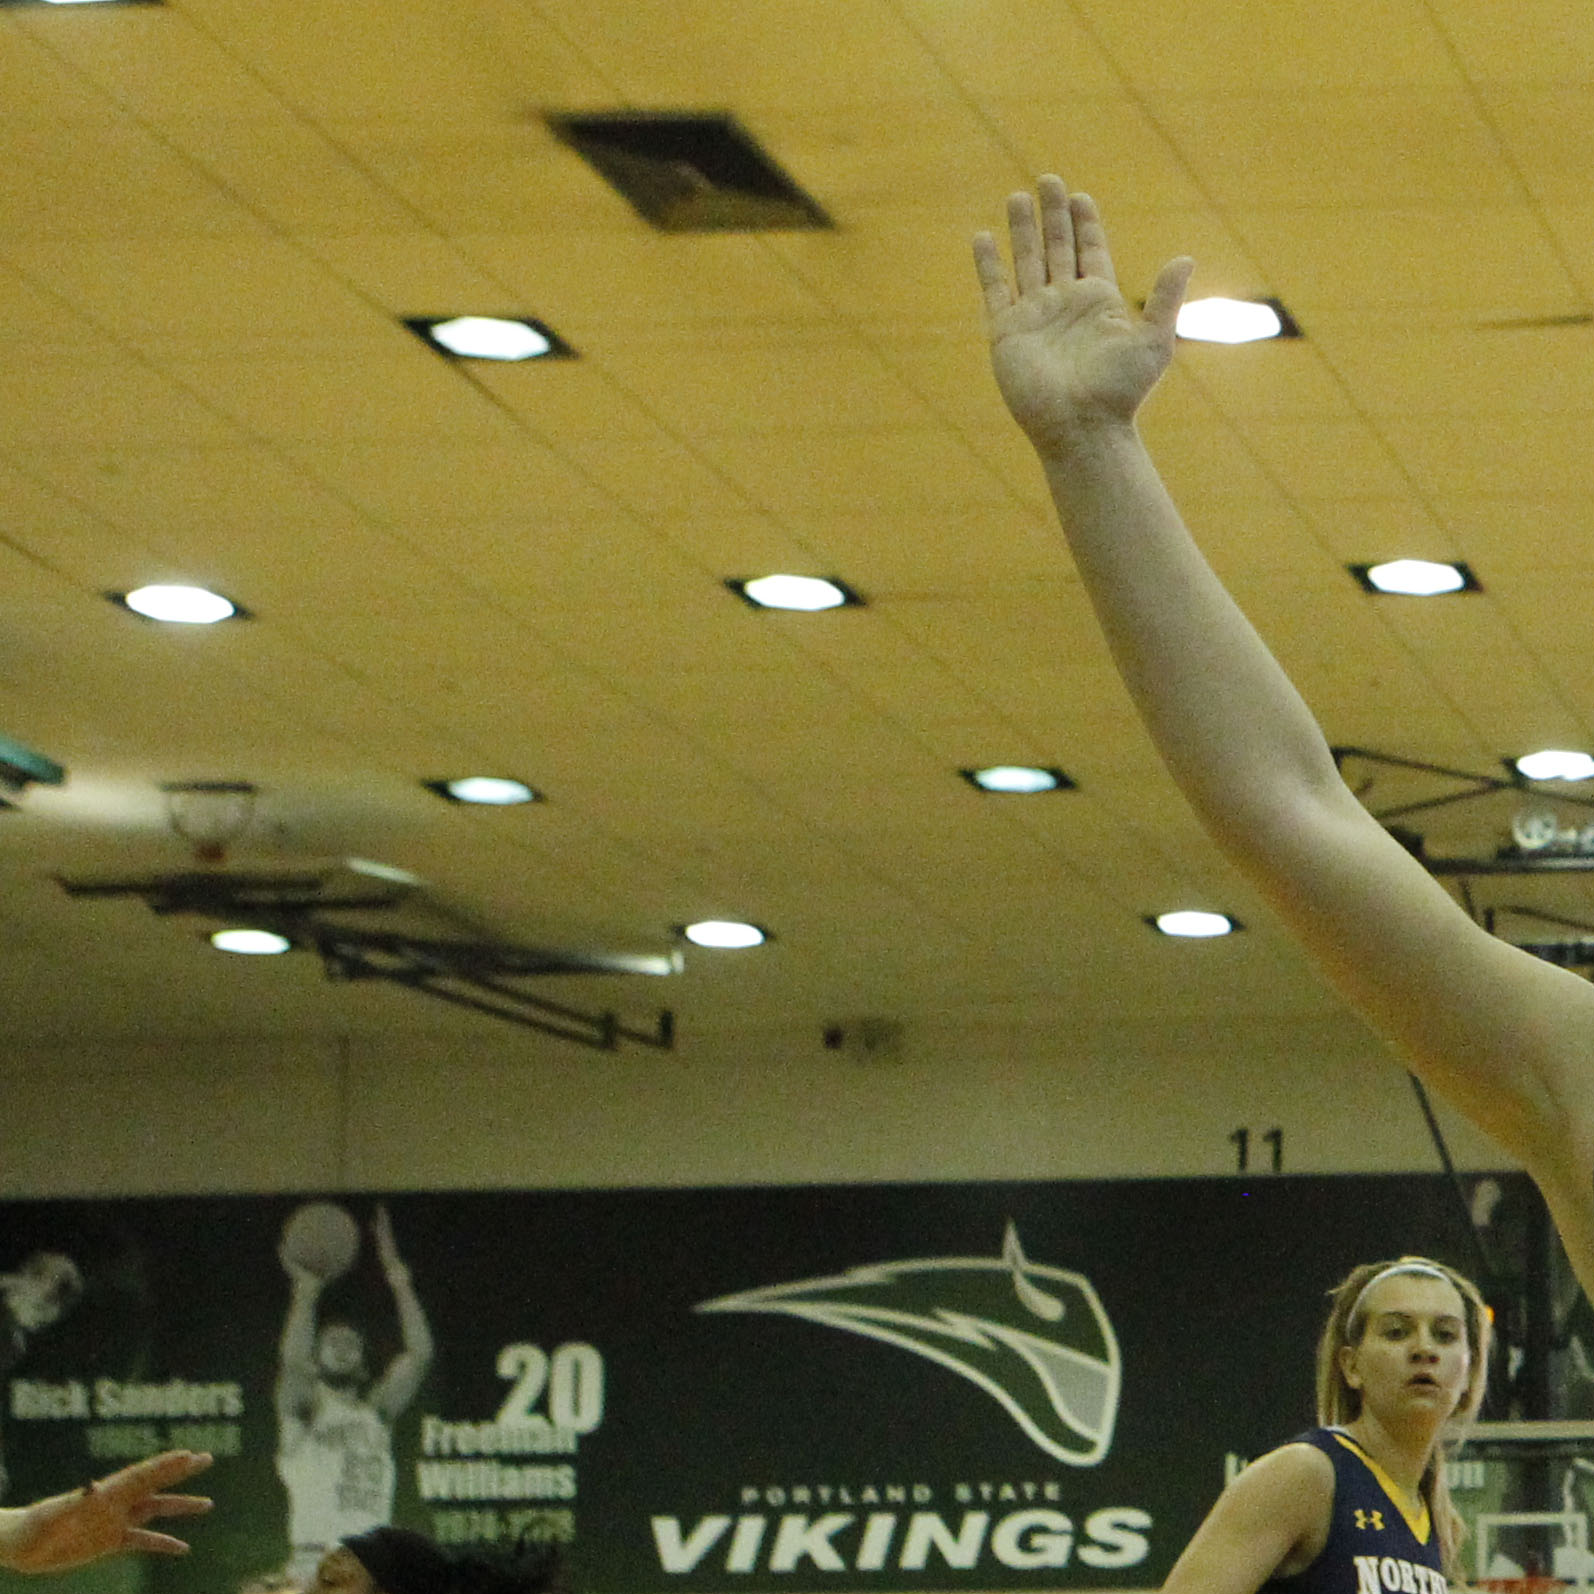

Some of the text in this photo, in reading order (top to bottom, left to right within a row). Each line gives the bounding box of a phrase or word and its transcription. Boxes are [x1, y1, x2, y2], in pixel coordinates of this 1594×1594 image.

[1228, 1127, 1283, 1172] 11
[496, 1341, 605, 1434] 20
[417, 1459, 578, 1500] Williams
[740, 1481, 1061, 1506] PORTLAND STATE
[650, 1506, 1154, 1575] VIKINGS
